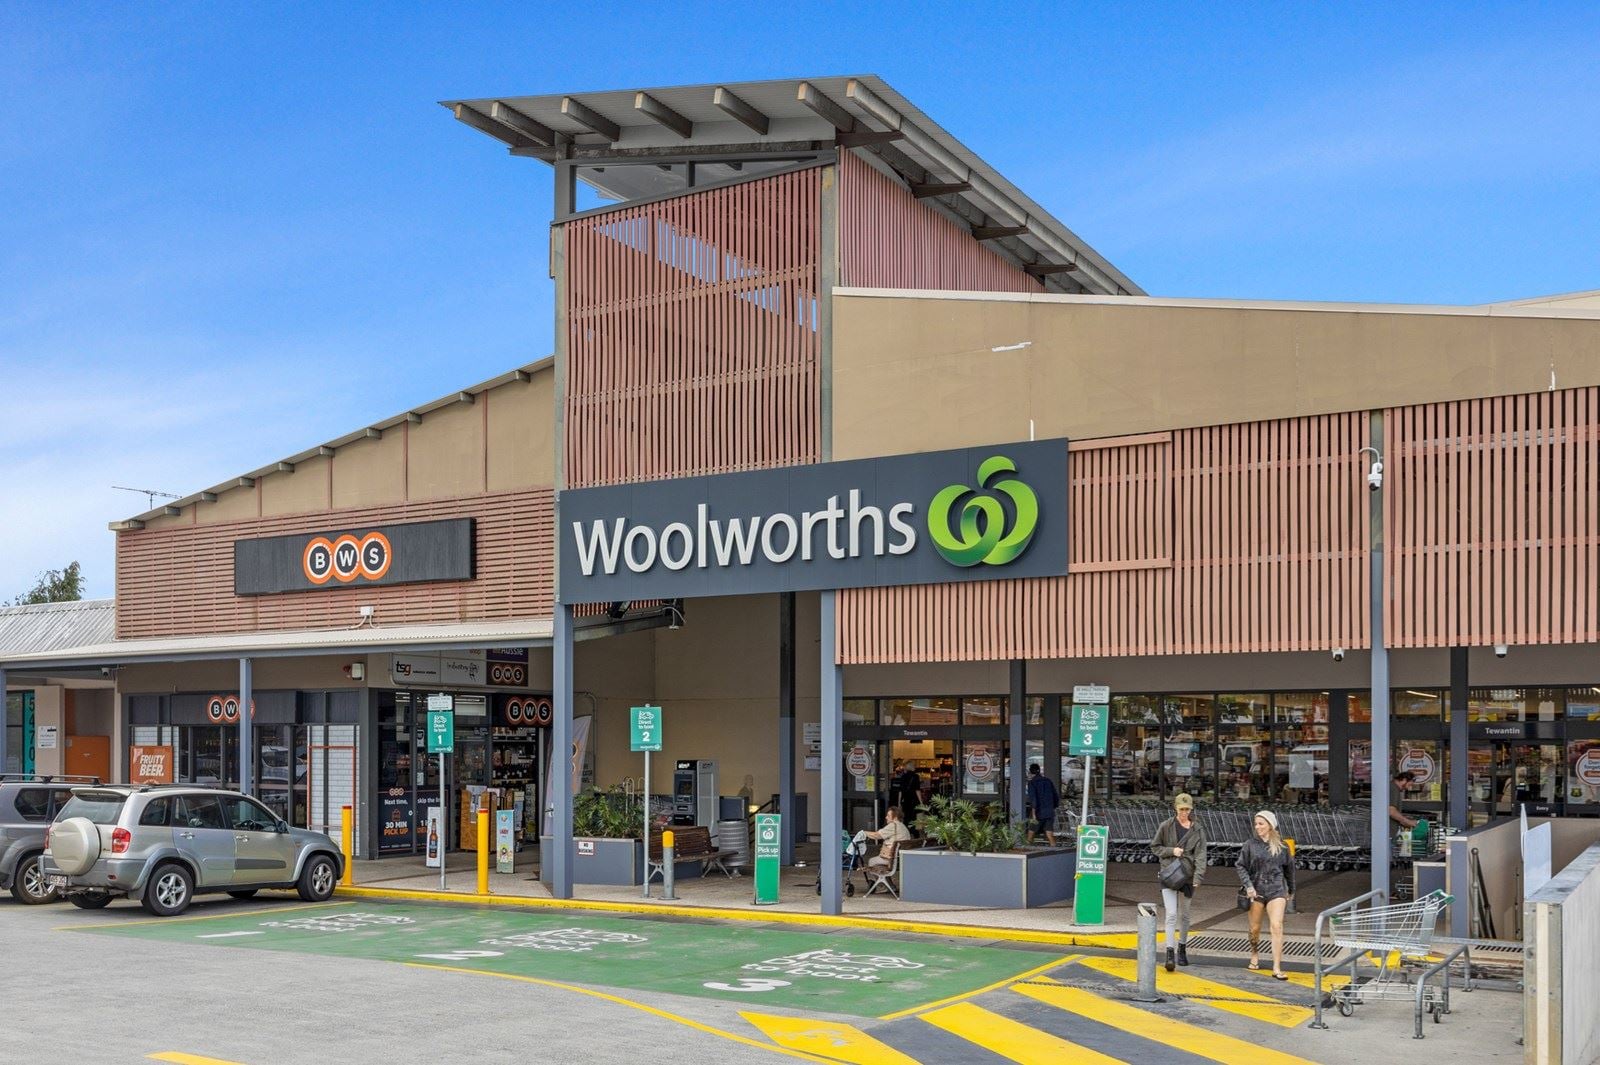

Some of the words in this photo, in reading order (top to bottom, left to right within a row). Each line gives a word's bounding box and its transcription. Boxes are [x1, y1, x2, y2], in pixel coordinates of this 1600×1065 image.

[573, 489, 916, 576] Woolworths
[314, 547, 380, 569] BWS
[396, 661, 411, 676] tsg
[496, 670, 521, 678] BWS
[512, 705, 548, 716] BWS
[438, 734, 442, 744] 1
[642, 731, 650, 742] 2
[1083, 733, 1092, 745] 3
[140, 754, 165, 765] FRUITY
[139, 764, 165, 777] BEER.
[385, 821, 394, 829] 30
[384, 828, 398, 836] PICK
[413, 950, 504, 960] 2
[762, 957, 879, 974] Direct
[741, 963, 780, 972] to
[785, 968, 881, 982] boot
[703, 978, 792, 992] 3
